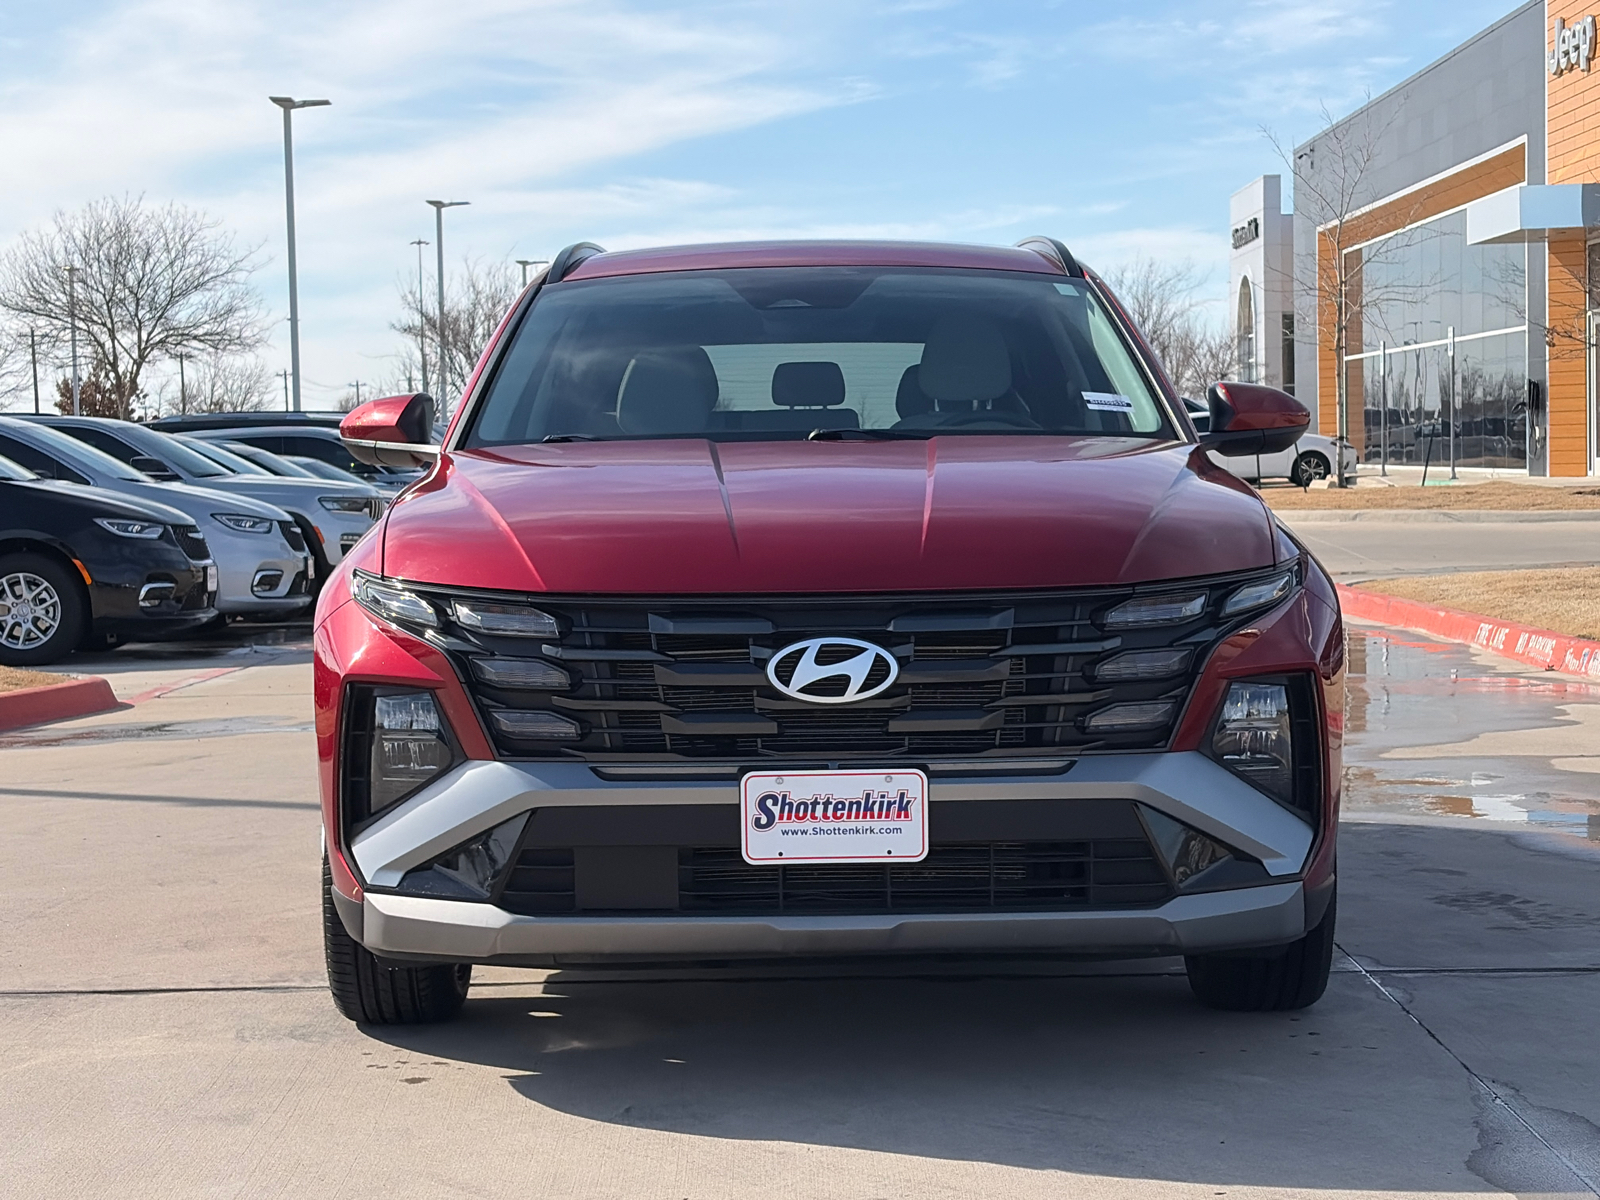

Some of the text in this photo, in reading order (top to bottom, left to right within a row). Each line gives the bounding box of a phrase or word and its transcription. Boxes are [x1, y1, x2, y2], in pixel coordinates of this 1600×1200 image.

[1548, 15, 1596, 76] Jeep
[752, 790, 916, 831] Shottenkirk
[781, 825, 903, 836] www.Shottenkirk.com
